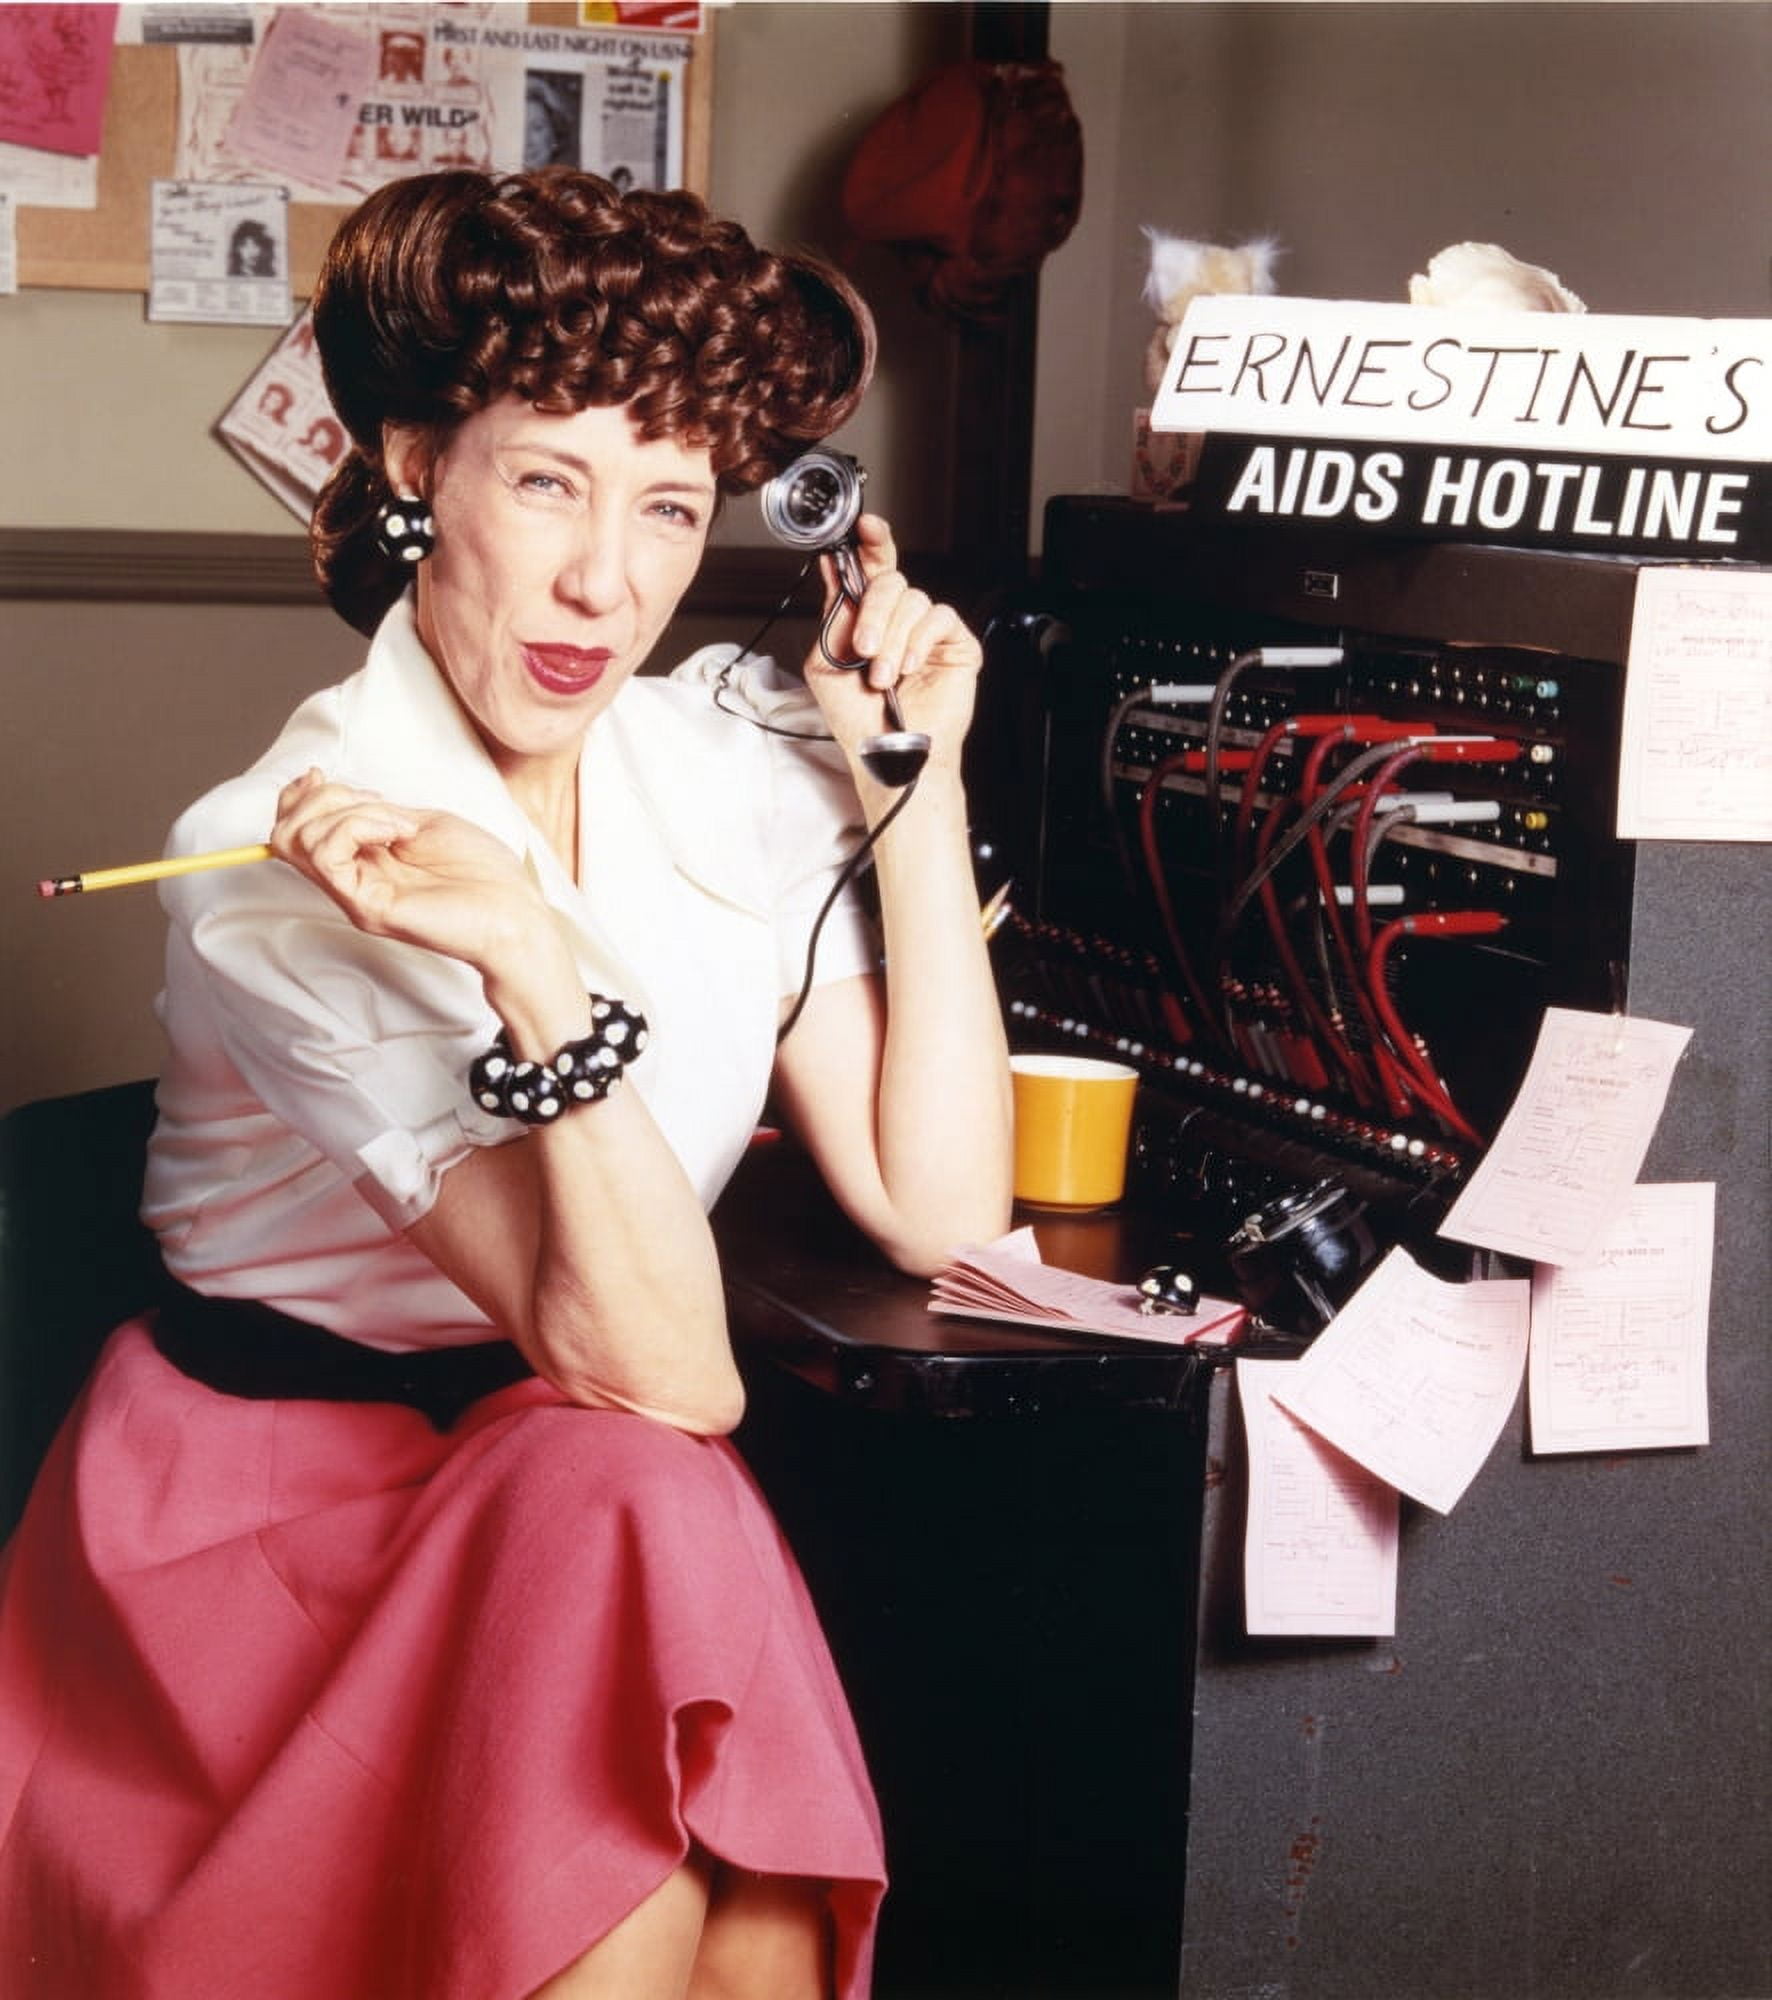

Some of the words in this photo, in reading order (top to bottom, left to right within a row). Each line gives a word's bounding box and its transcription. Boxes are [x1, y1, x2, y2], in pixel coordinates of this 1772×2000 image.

[482, 28, 521, 48] AND
[522, 31, 561, 52] LAST
[564, 35, 618, 56] NIGHT
[620, 38, 649, 59] ON
[401, 104, 466, 129] WILD
[1175, 334, 1764, 435] ERNESTINE'S
[1226, 446, 1405, 521] AIDS
[1421, 456, 1750, 543] HOTLINE
